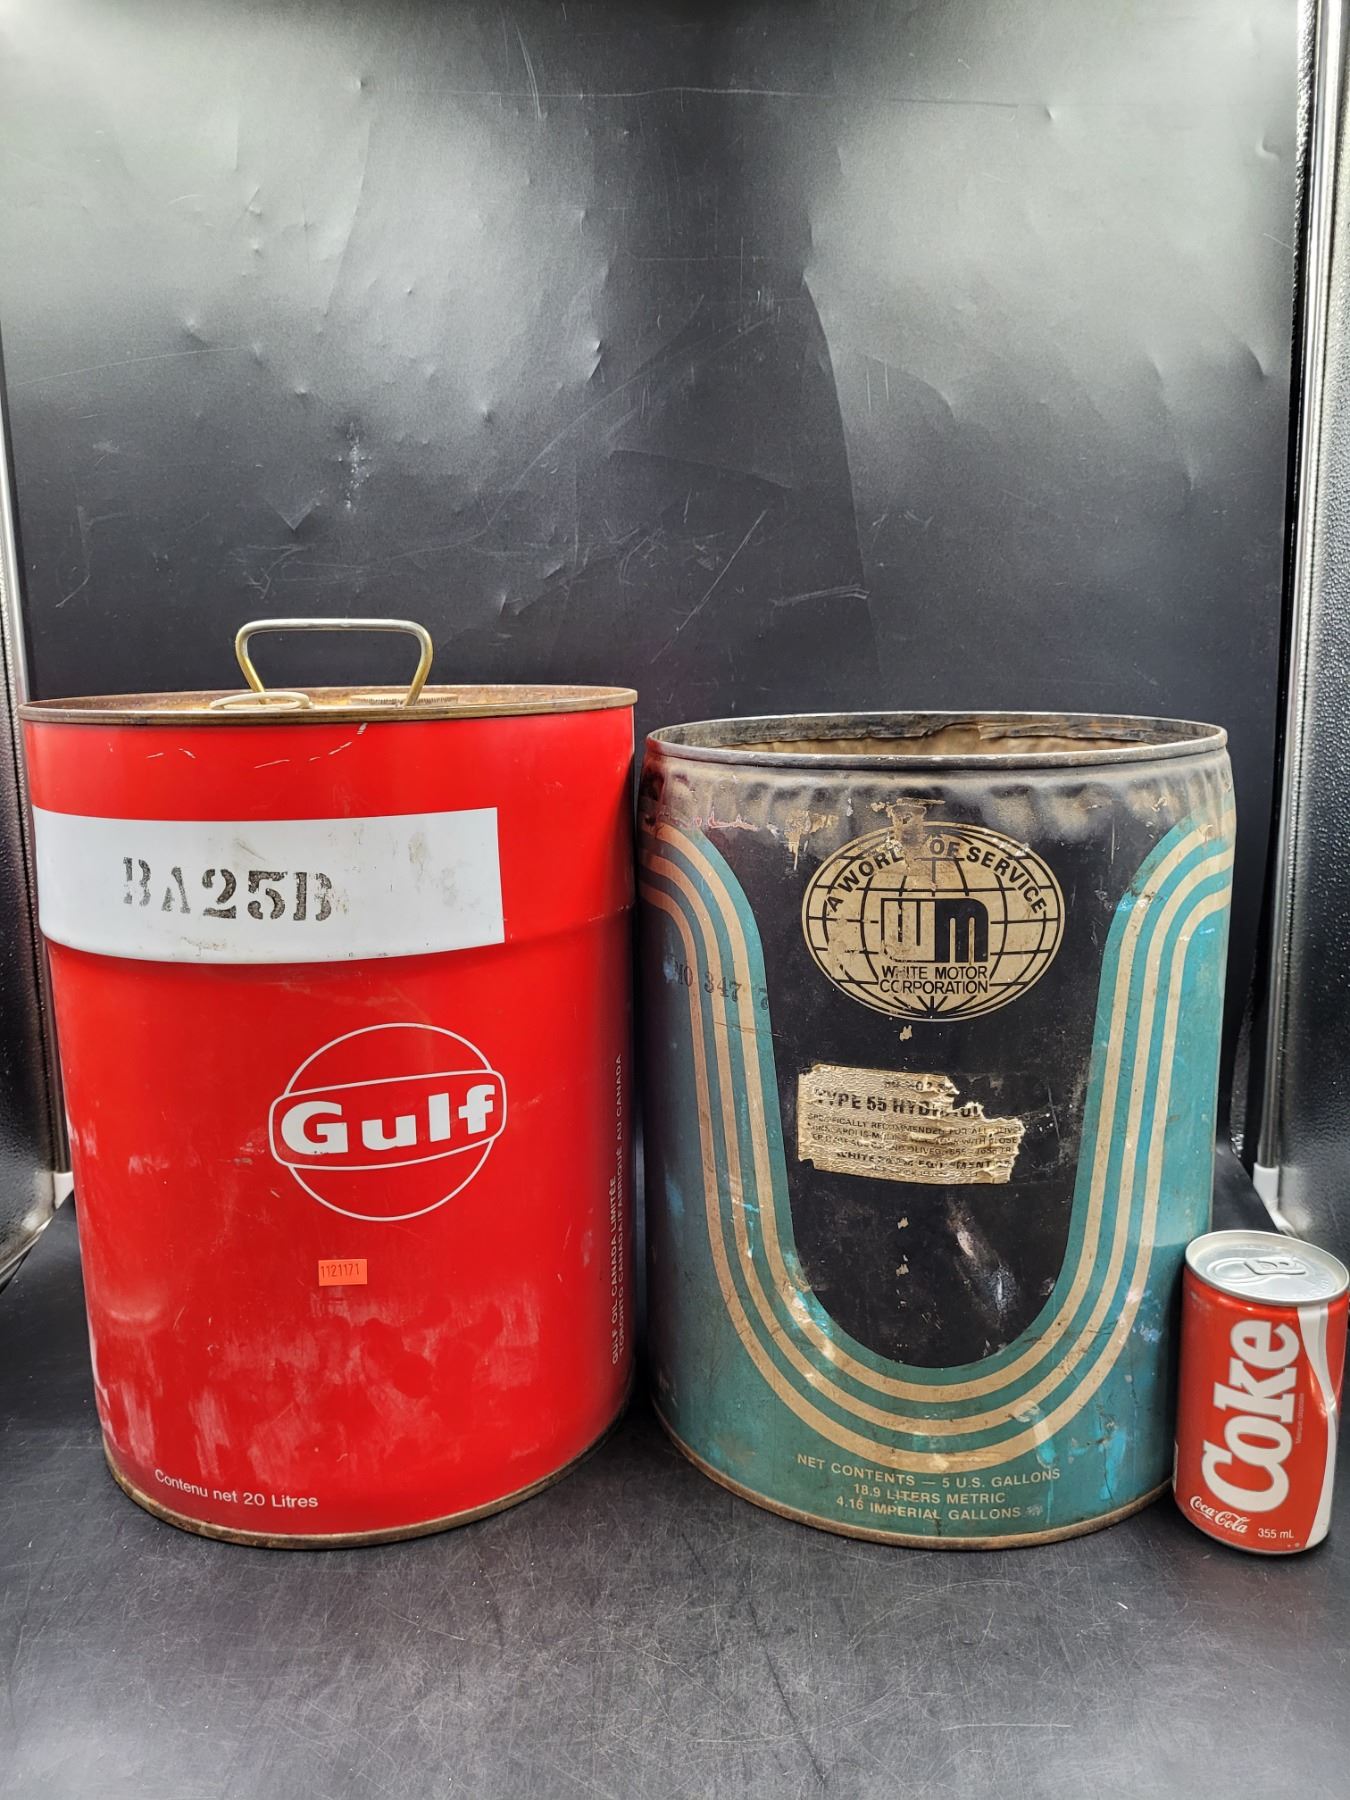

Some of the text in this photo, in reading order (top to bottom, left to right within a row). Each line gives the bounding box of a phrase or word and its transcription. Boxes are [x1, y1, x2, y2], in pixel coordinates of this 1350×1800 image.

[123, 857, 332, 921] BA25B
[827, 841, 1046, 914] A WORL OF SERVICE
[880, 979, 989, 994] CORPORATION
[934, 965, 988, 980] MOTOR
[281, 1084, 496, 1155] Gulf
[866, 1095, 887, 1112] 55
[320, 1263, 360, 1278] 1121171
[610, 1235, 618, 1296] CANADA
[611, 1328, 619, 1364] GULF
[1202, 1319, 1300, 1512] Coke
[155, 1468, 319, 1508] Contenu net 20 Litres
[797, 1453, 826, 1471] NET
[831, 1462, 915, 1487] CONTENTS
[942, 1478, 950, 1489] 5
[956, 1477, 985, 1489] U.S.
[991, 1468, 1061, 1488] GALLONS
[836, 1495, 864, 1511] 4.16
[870, 1503, 941, 1520] IMPERIAL
[948, 1506, 1021, 1520] GALLONS
[853, 1483, 1006, 1505] 18.9 LITERS METRIC
[1257, 1528, 1294, 1539] 355 mL
